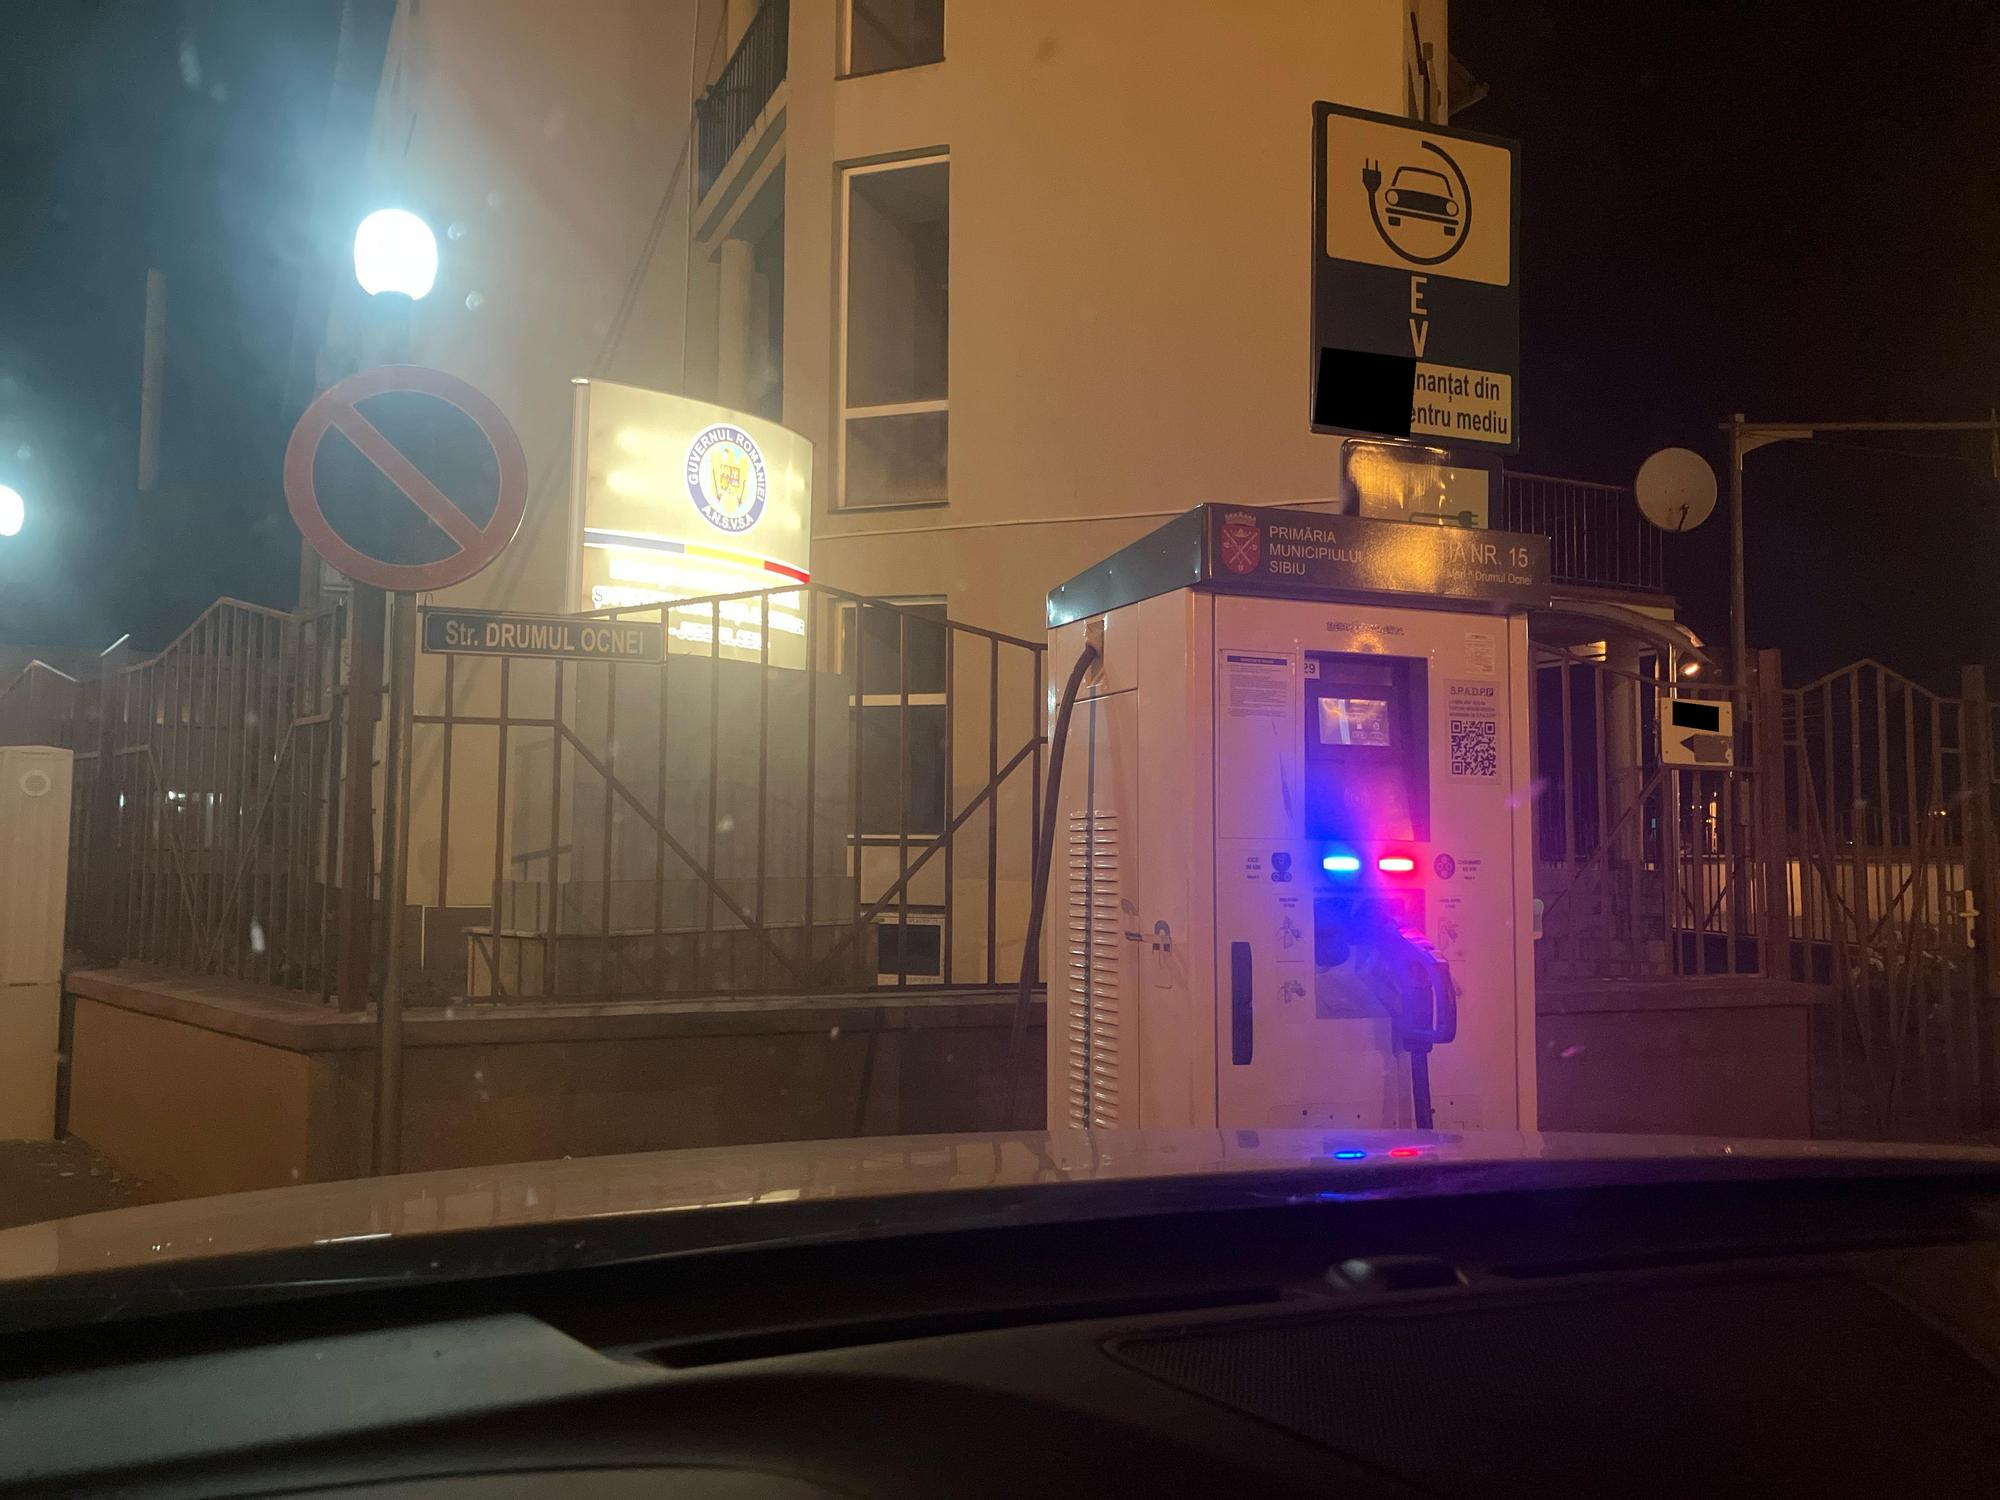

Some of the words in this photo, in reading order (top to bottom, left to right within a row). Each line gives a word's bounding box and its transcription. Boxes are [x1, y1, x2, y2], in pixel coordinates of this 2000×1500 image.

[1416, 373, 1469, 402] nanțat
[1474, 376, 1500, 400] din
[1411, 404, 1451, 427] entru
[1456, 410, 1508, 435] mediu
[688, 428, 734, 485] GUVERNUL
[1268, 525, 1337, 544] PRIMĂRIA
[1268, 545, 1362, 564] MUNICIPIULUI
[1471, 543, 1502, 566] NR.
[1508, 547, 1529, 568] 15
[1268, 560, 1306, 577] SIBIU
[445, 620, 479, 646] Str.
[485, 622, 575, 651] DRUMUL
[580, 627, 644, 654] OCNEI
